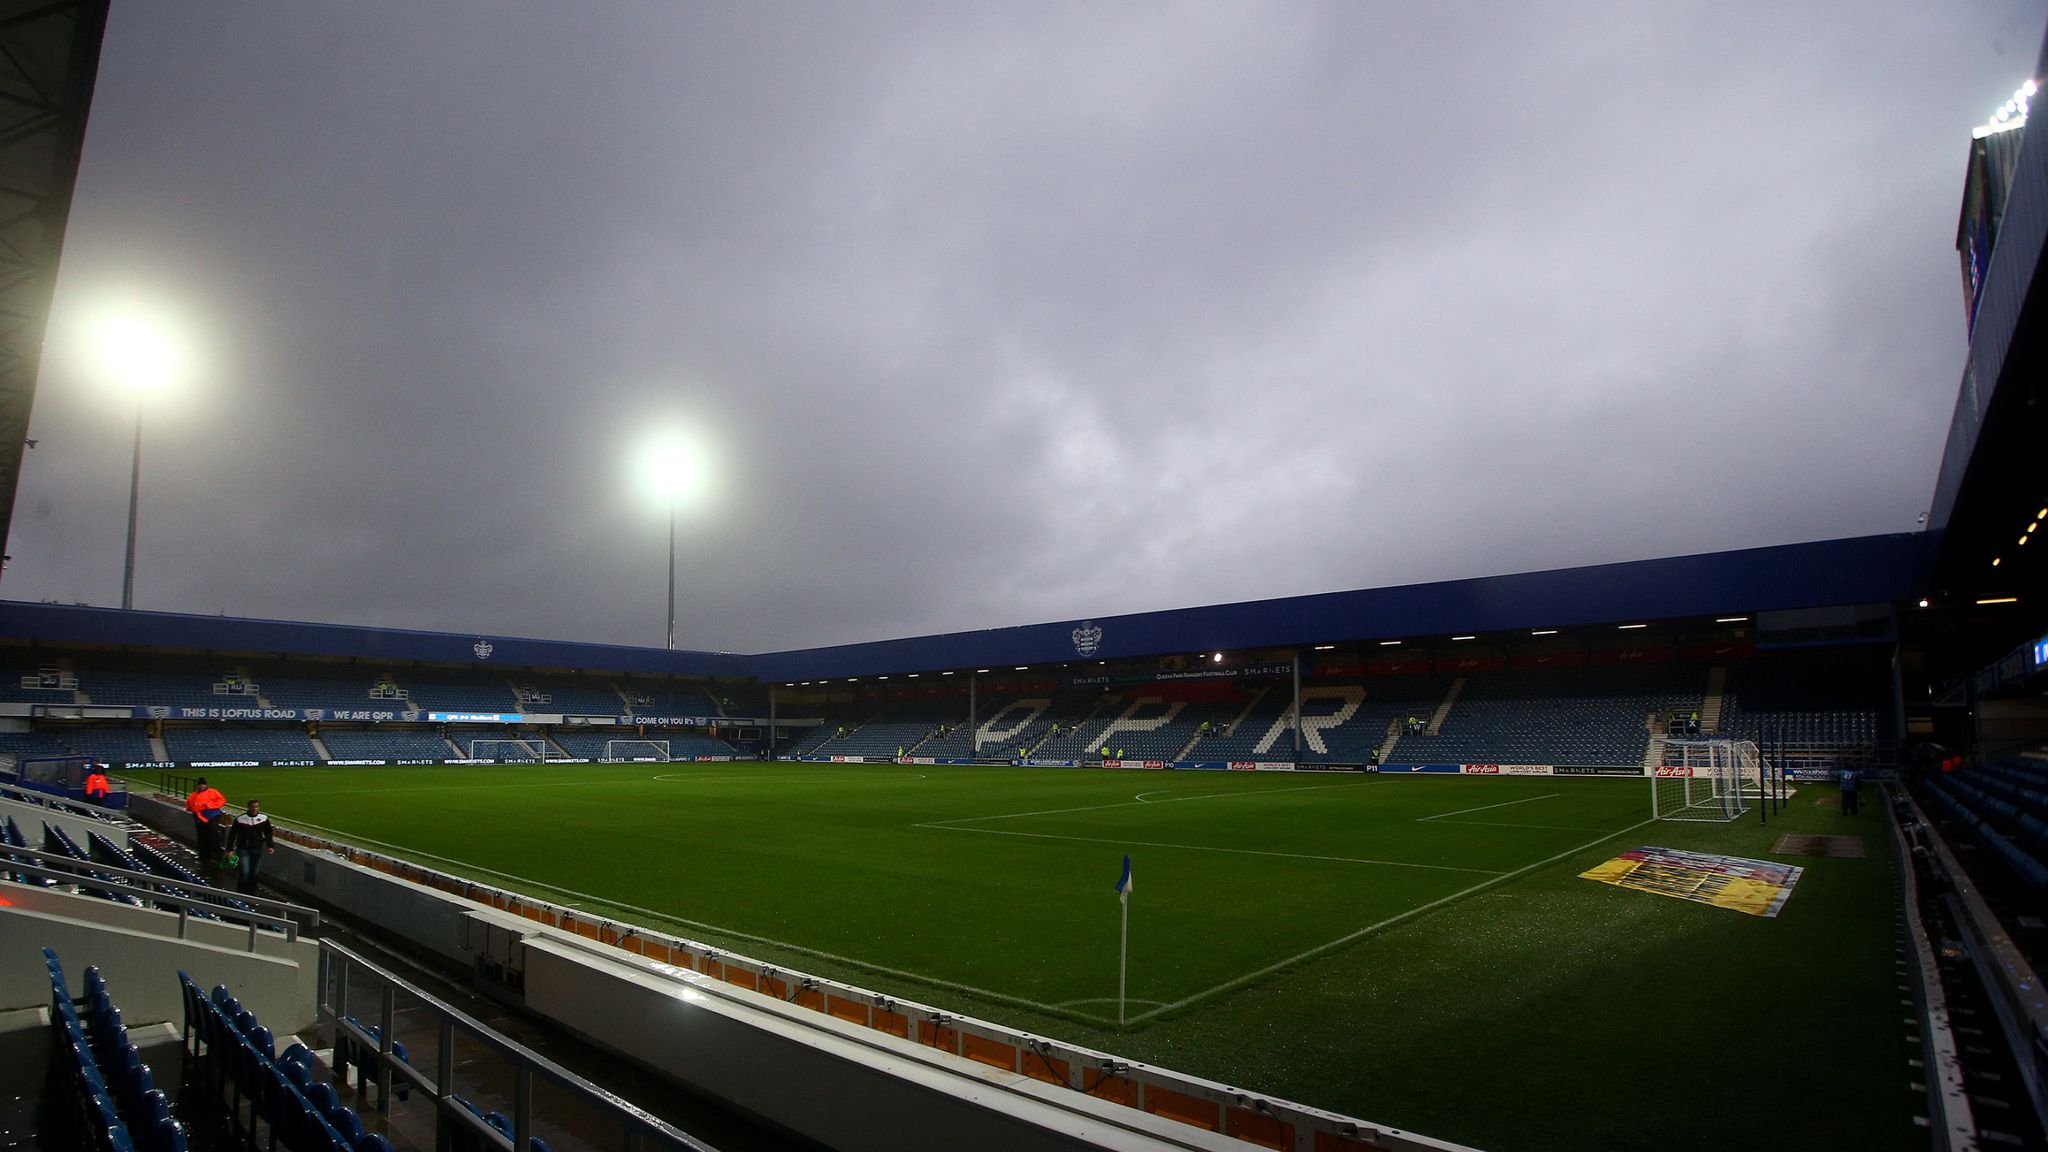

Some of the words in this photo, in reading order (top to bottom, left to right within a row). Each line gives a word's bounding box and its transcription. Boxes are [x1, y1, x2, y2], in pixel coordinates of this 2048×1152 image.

[182, 708, 207, 718] THIS
[209, 708, 219, 718] IS
[222, 708, 262, 719] LOFTUS
[264, 709, 296, 719] ROAD
[334, 711, 349, 719] WE
[351, 711, 370, 720] ARE
[372, 711, 394, 720] QPR
[636, 717, 657, 725] COME
[658, 717, 669, 725] ON
[1689, 720, 1697, 728] X
